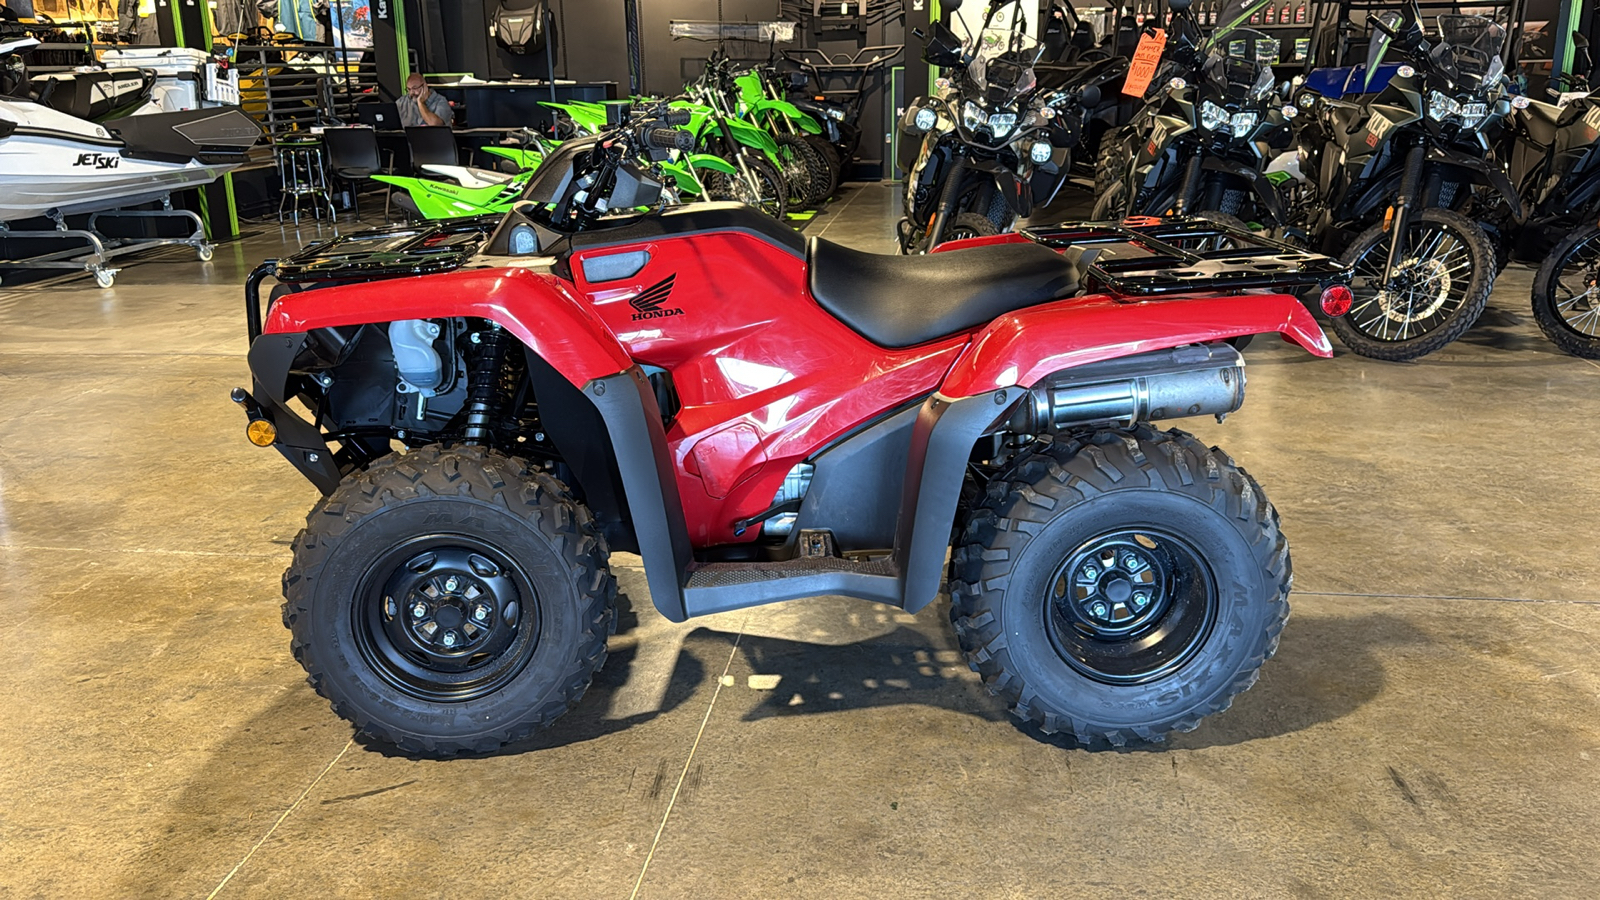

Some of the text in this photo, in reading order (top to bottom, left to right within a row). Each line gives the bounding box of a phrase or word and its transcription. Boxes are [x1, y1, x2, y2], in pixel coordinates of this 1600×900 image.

[1365, 111, 1389, 140] KLR
[429, 183, 460, 195] Kawasaki
[631, 307, 685, 321] HONDA
